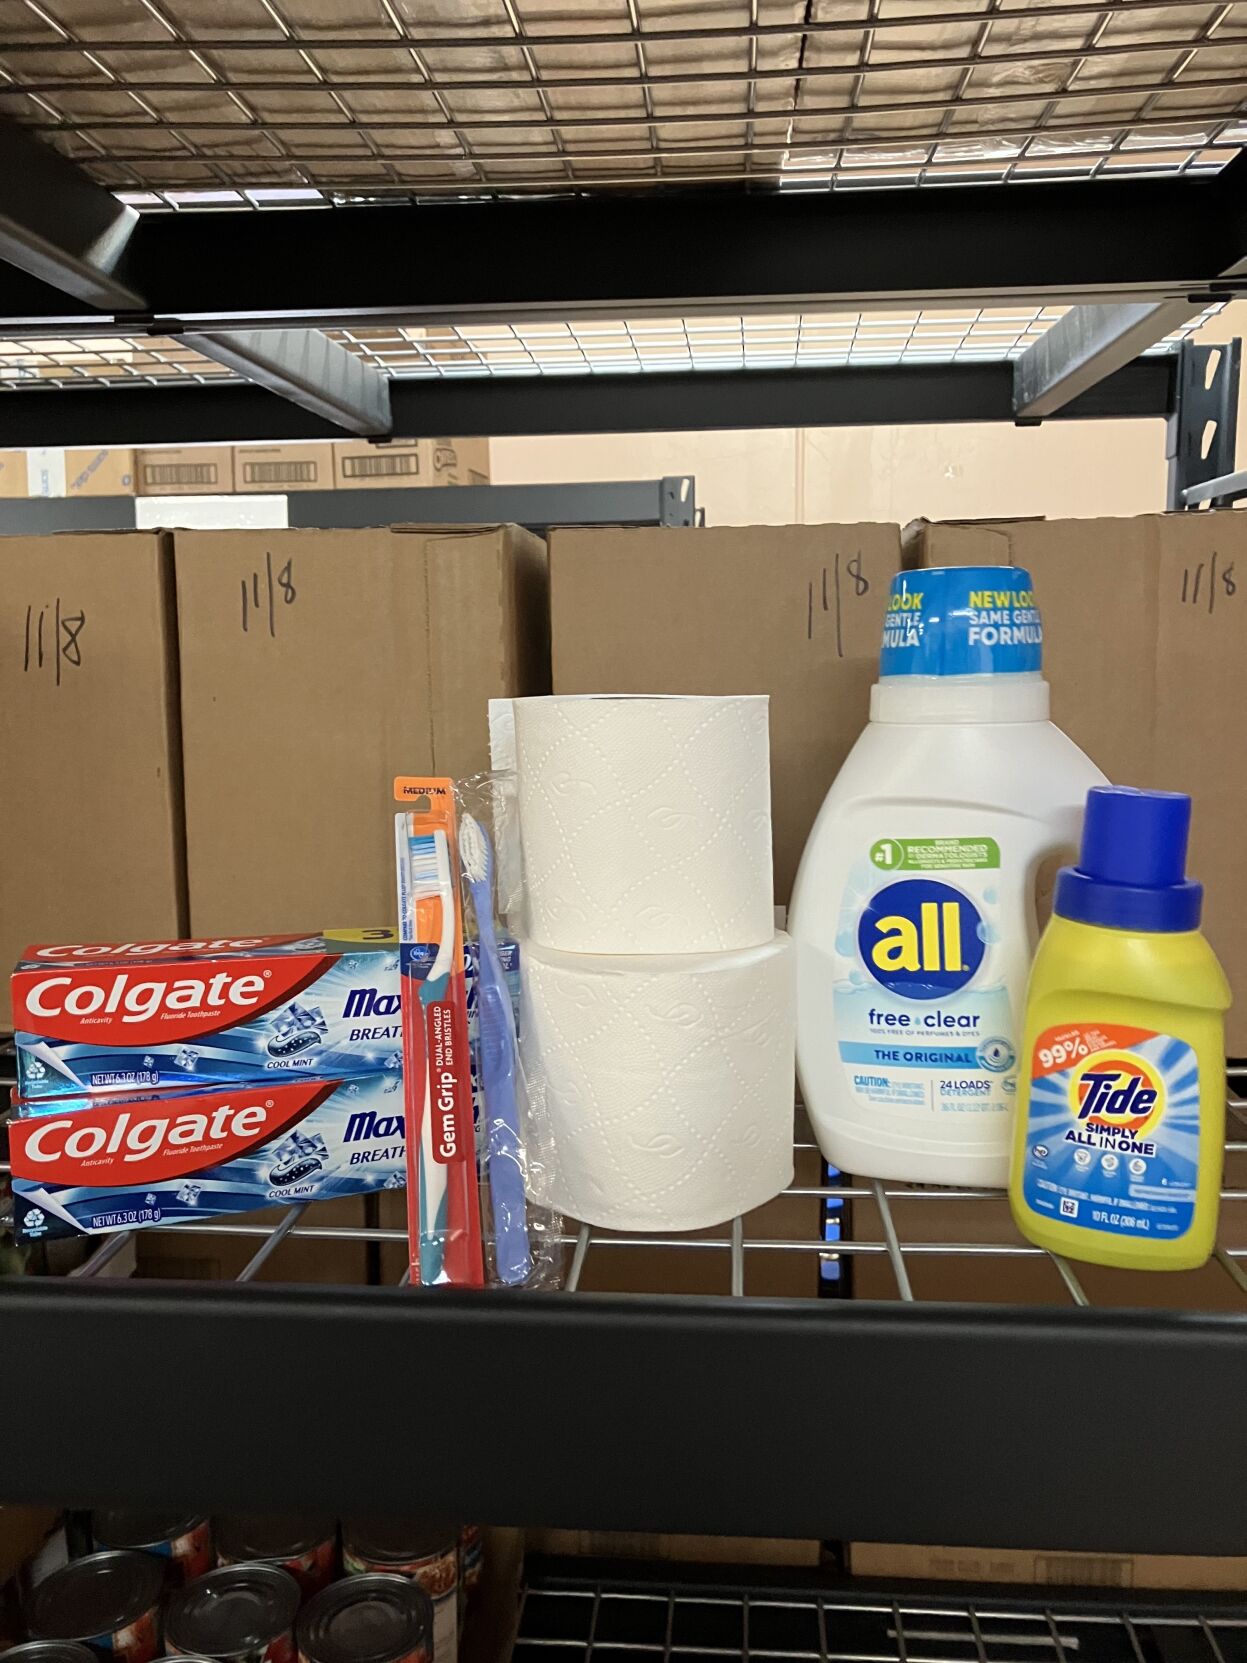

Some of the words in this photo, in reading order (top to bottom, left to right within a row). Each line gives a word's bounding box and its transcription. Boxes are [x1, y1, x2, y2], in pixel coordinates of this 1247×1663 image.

[968, 591, 1010, 609] NEW
[968, 610, 1010, 625] SAME
[403, 786, 446, 796] MEDIUM
[875, 843, 893, 865] #1
[907, 844, 988, 853] RECOMMENDED
[871, 902, 962, 973] all
[35, 937, 266, 959] Colgate
[25, 971, 266, 1024] Colgate
[80, 1017, 113, 1025] Anticavity
[187, 1010, 221, 1019] Toothpaste
[869, 1008, 911, 1027] free
[924, 1010, 981, 1028] clear
[433, 1006, 444, 1067] DUAL-ANGLED
[443, 1009, 453, 1047] BRISTLES
[444, 1047, 454, 1067] END
[874, 1050, 900, 1061] THE
[903, 1051, 973, 1063] ORIGINAL
[1038, 1037, 1089, 1068] 99%
[267, 1061, 290, 1069] COOL
[437, 1072, 457, 1112] Grip
[940, 1080, 953, 1090] 24
[1078, 1072, 1158, 1120] Tide
[24, 1102, 268, 1162] Colgate
[440, 1113, 457, 1158] Gem
[1085, 1123, 1138, 1140] SIMPLY
[1065, 1130, 1097, 1147] ALL
[1099, 1137, 1116, 1150] IN
[1118, 1140, 1155, 1155] ONE
[80, 1157, 115, 1167] Anticavity
[269, 1189, 292, 1197] COOL
[294, 1185, 315, 1194] MINT
[93, 1216, 103, 1228] NET
[117, 1213, 127, 1225] 6.3
[127, 1212, 137, 1223] OZ
